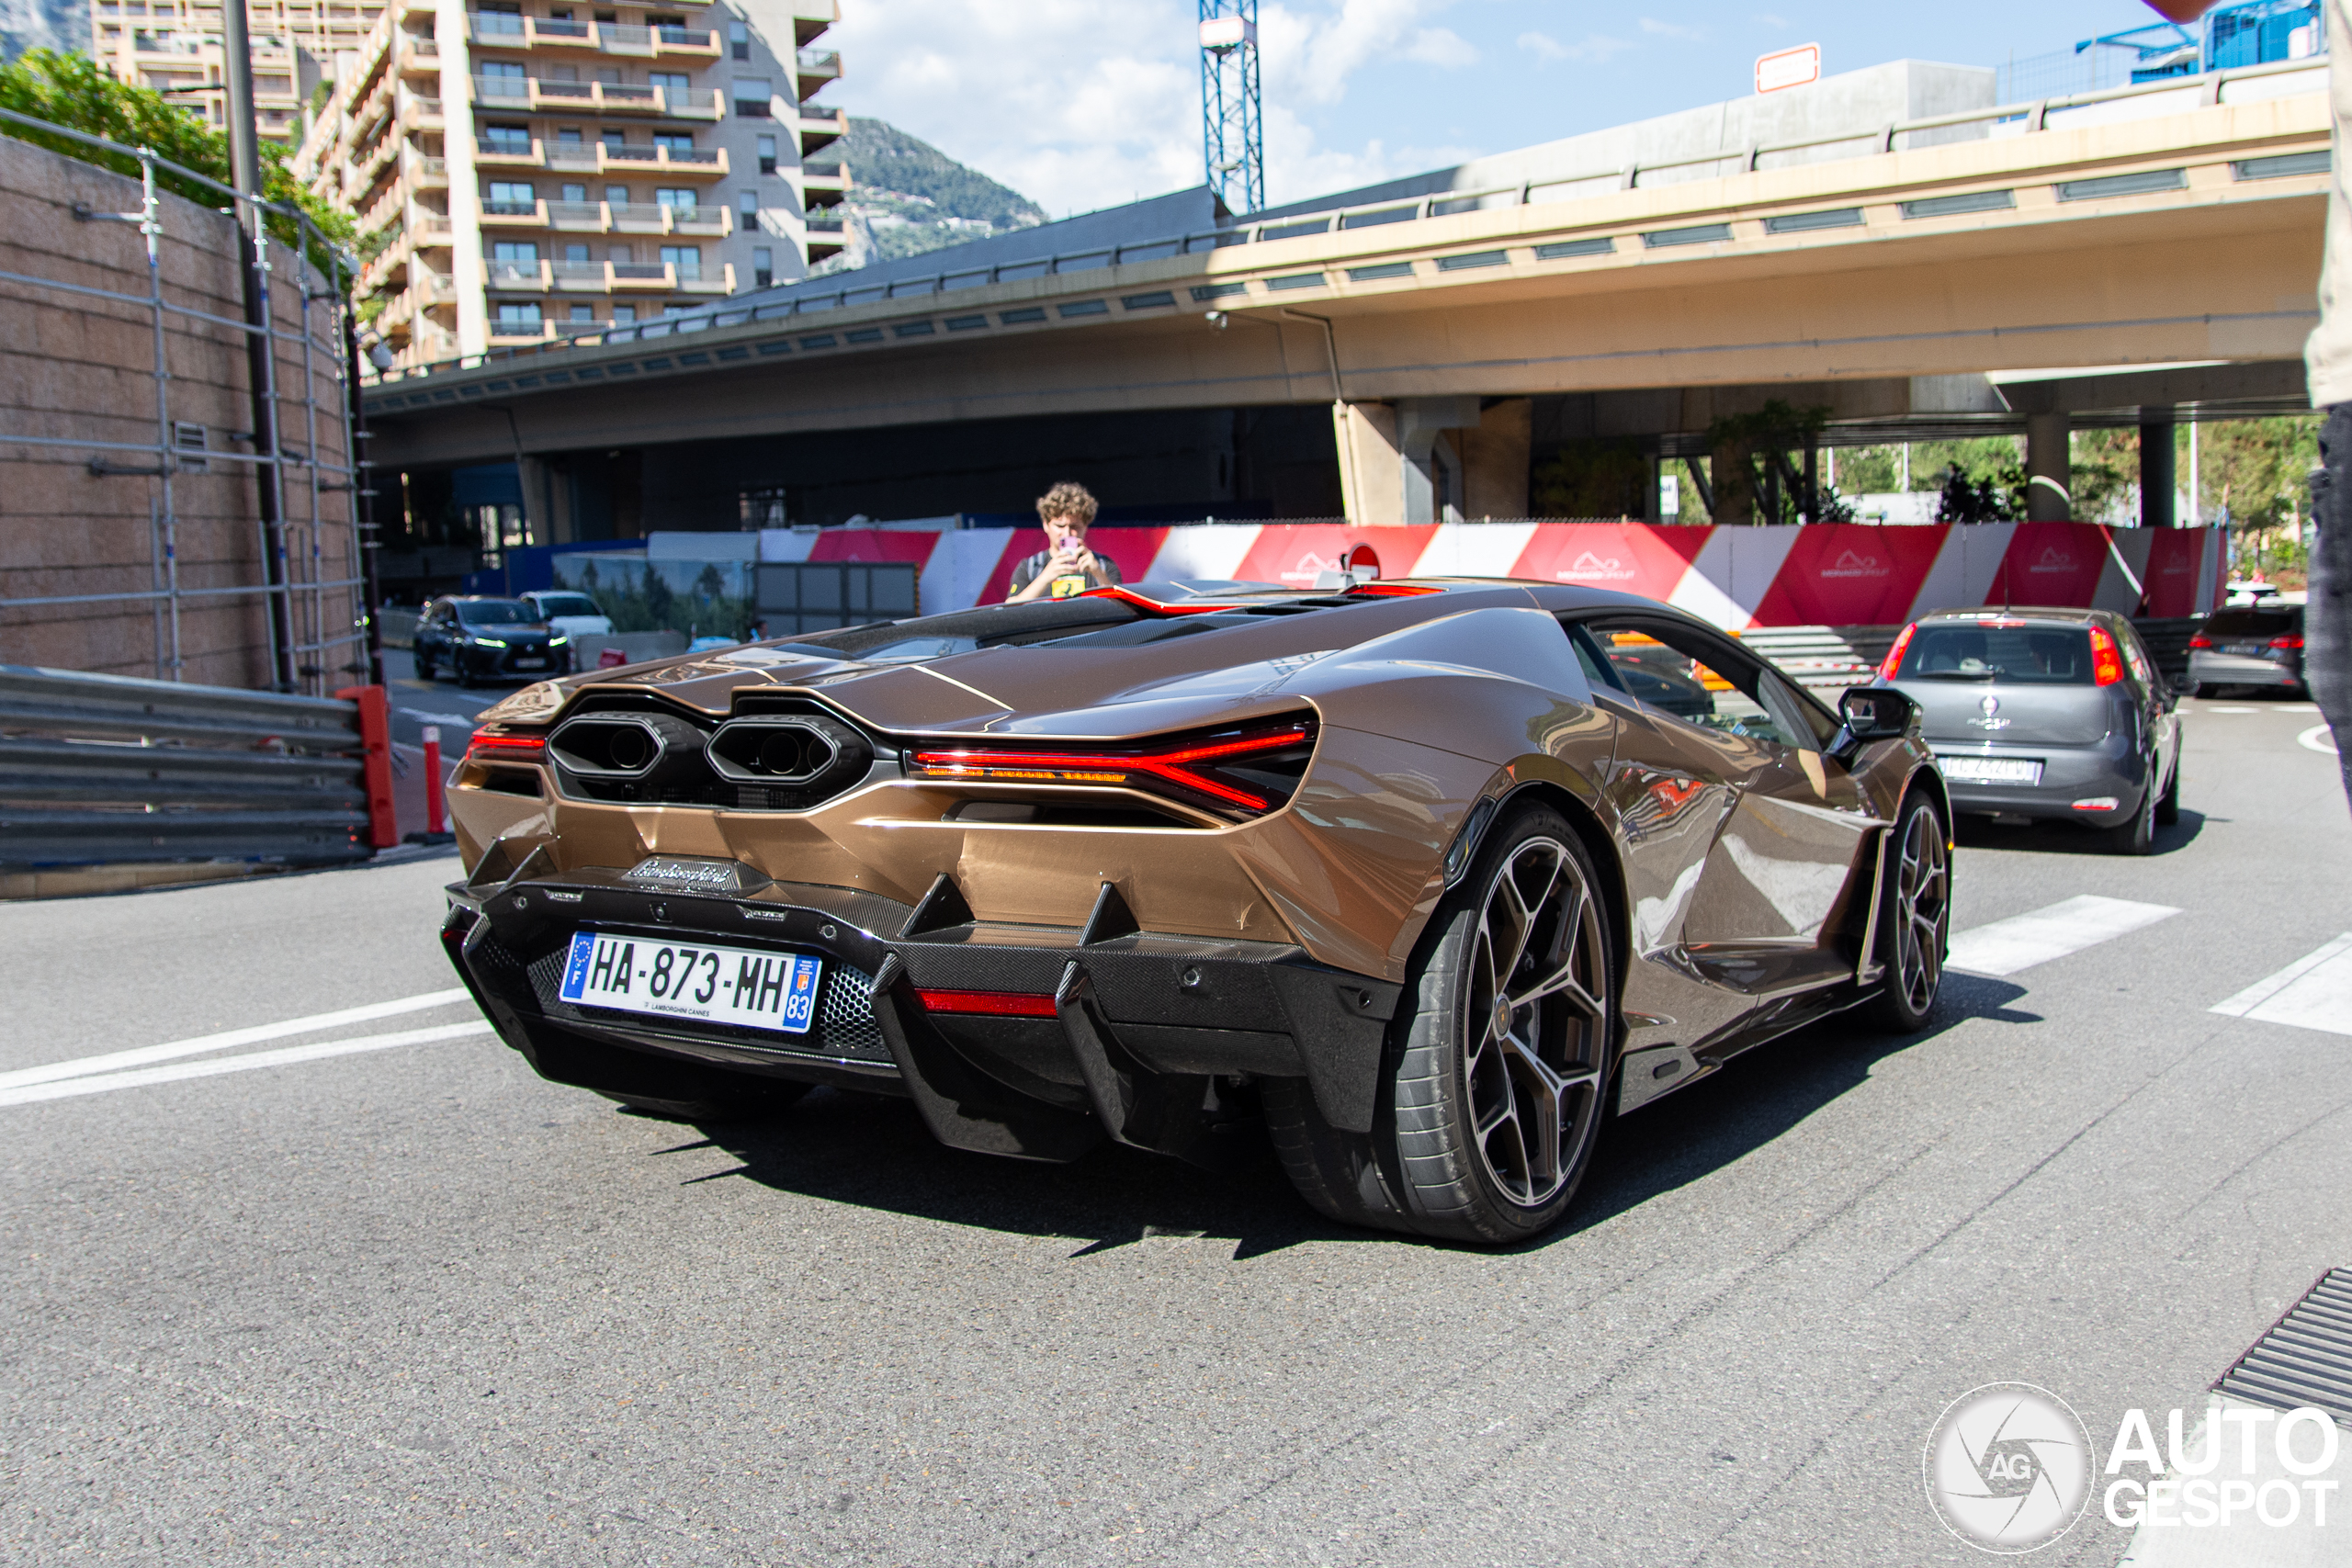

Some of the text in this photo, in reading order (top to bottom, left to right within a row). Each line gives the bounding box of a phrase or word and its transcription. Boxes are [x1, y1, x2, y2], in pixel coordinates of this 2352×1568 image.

[571, 970, 582, 986] F
[590, 941, 786, 1013] HA-873-MH
[651, 1004, 710, 1017] LAMBORGHINI CANNES
[786, 994, 809, 1020] 83
